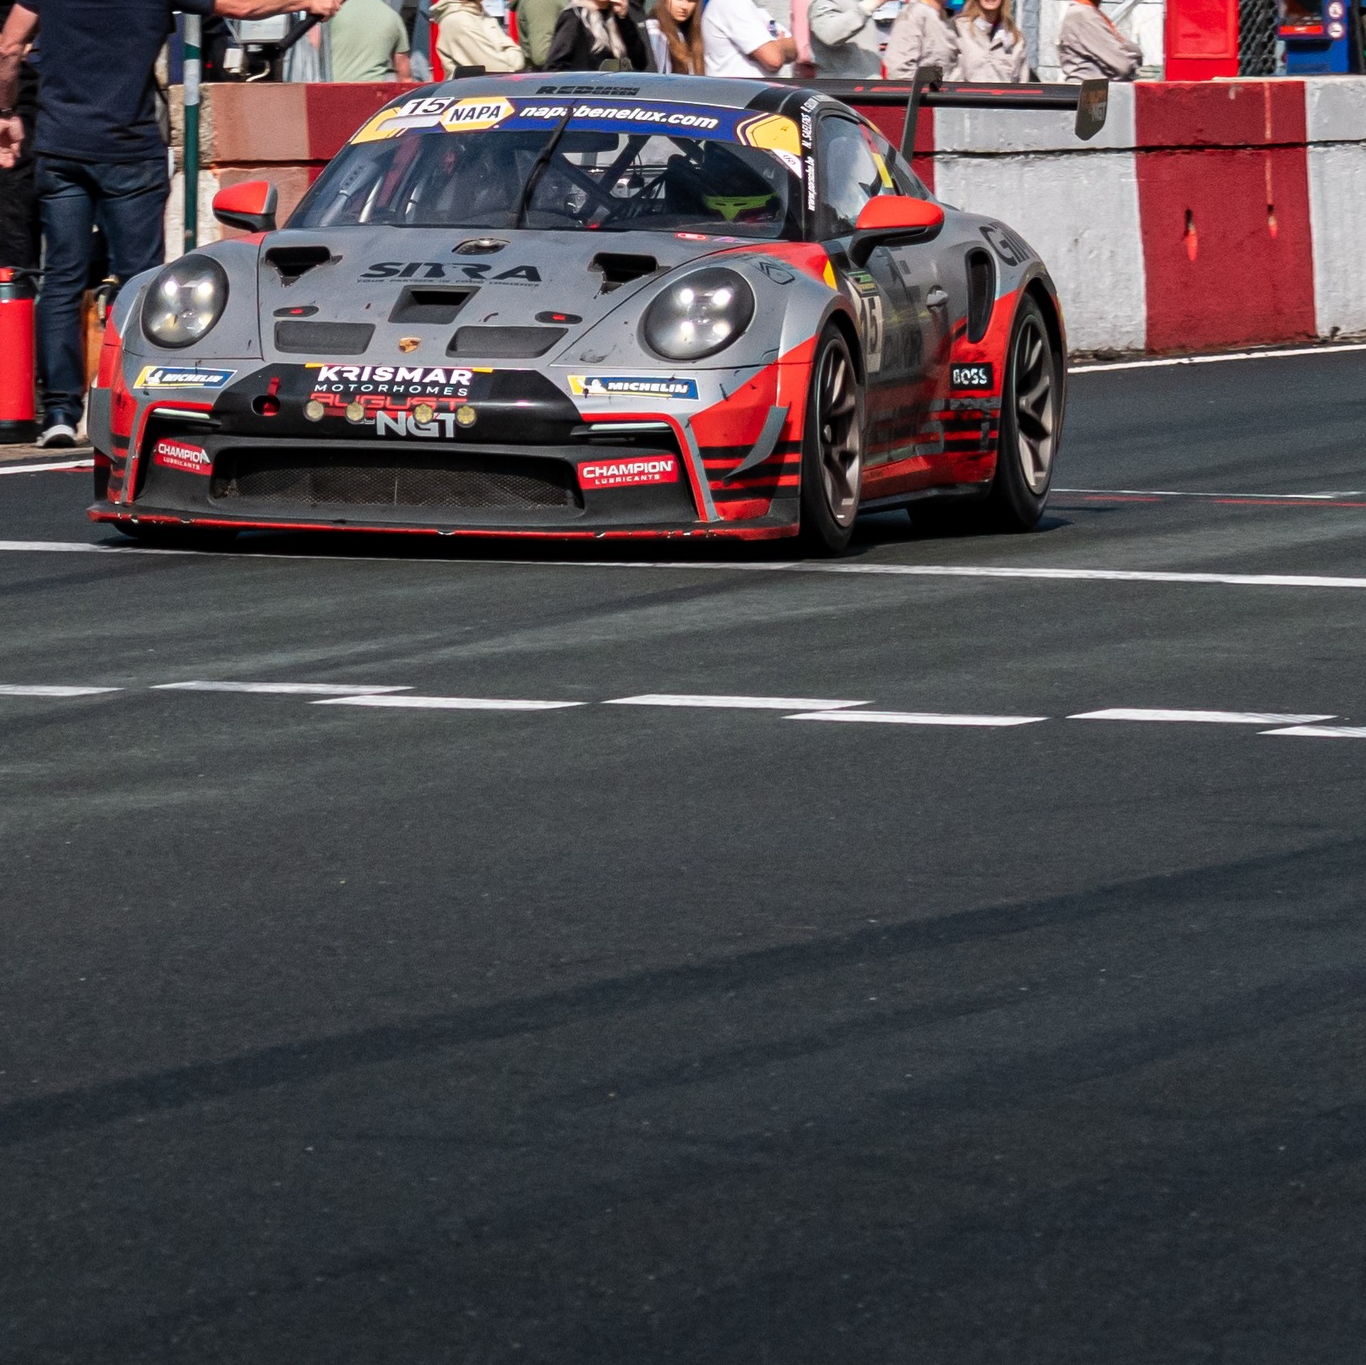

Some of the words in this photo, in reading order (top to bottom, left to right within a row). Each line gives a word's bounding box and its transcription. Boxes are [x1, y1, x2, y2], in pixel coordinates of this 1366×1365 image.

[407, 98, 447, 115] 15
[449, 105, 502, 122] NAPA
[162, 373, 224, 383] MICHELIN
[317, 366, 474, 386] KRISMAR
[952, 367, 988, 385] BOSS
[314, 383, 469, 397] MOTORHOMES
[608, 382, 689, 394] MICHELIN
[310, 392, 468, 412] AUGUST
[163, 455, 201, 471] LUBRICANTS
[582, 461, 673, 479] CHAMPION
[595, 473, 661, 485] LUBRICANTS
